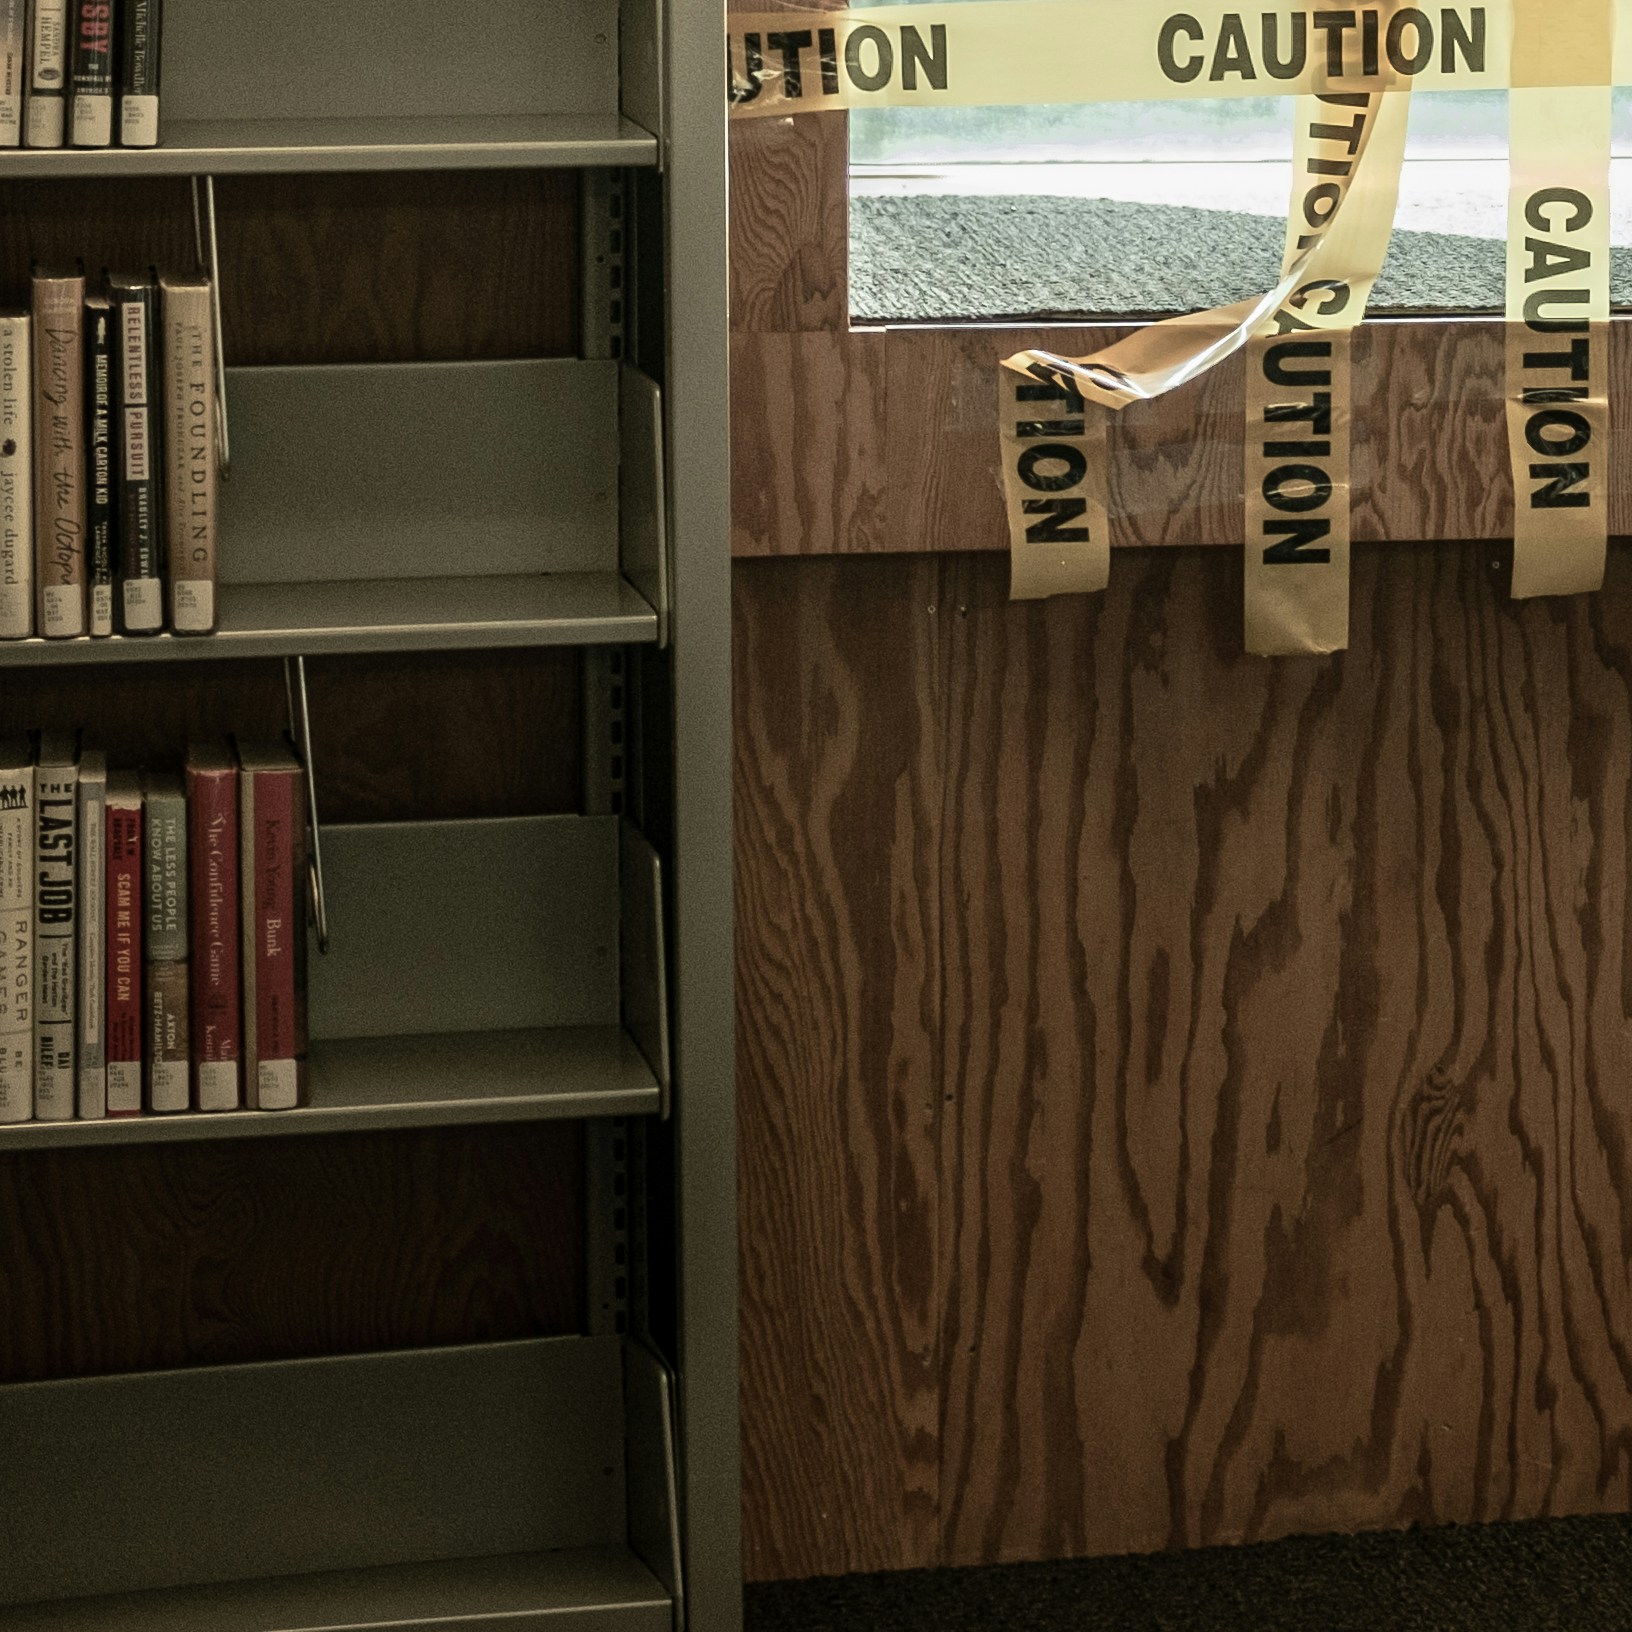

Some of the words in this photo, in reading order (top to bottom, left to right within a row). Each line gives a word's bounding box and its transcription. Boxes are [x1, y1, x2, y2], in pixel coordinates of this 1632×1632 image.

[727, 23, 949, 105] TION
[1157, 6, 1487, 84] CAUTION
[3, 341, 13, 394] stolen
[126, 307, 141, 400] RELENTLESS
[191, 326, 201, 367] THE
[1523, 187, 1593, 509] CAUTION
[3, 400, 13, 426] life
[1262, 278, 1352, 565] CAUTION
[129, 412, 144, 478] PURSUIT
[191, 382, 207, 563] FOUNDLING
[40, 783, 72, 793] THE
[39, 799, 73, 866] LAST
[39, 872, 73, 924] JOB
[117, 873, 131, 906] SCAM
[117, 911, 131, 926] ME
[117, 933, 131, 944] IF
[266, 919, 281, 957] Bunk
[15, 920, 28, 1022] RANGER
[117, 949, 131, 973] YOU
[117, 975, 131, 1001] CAN
